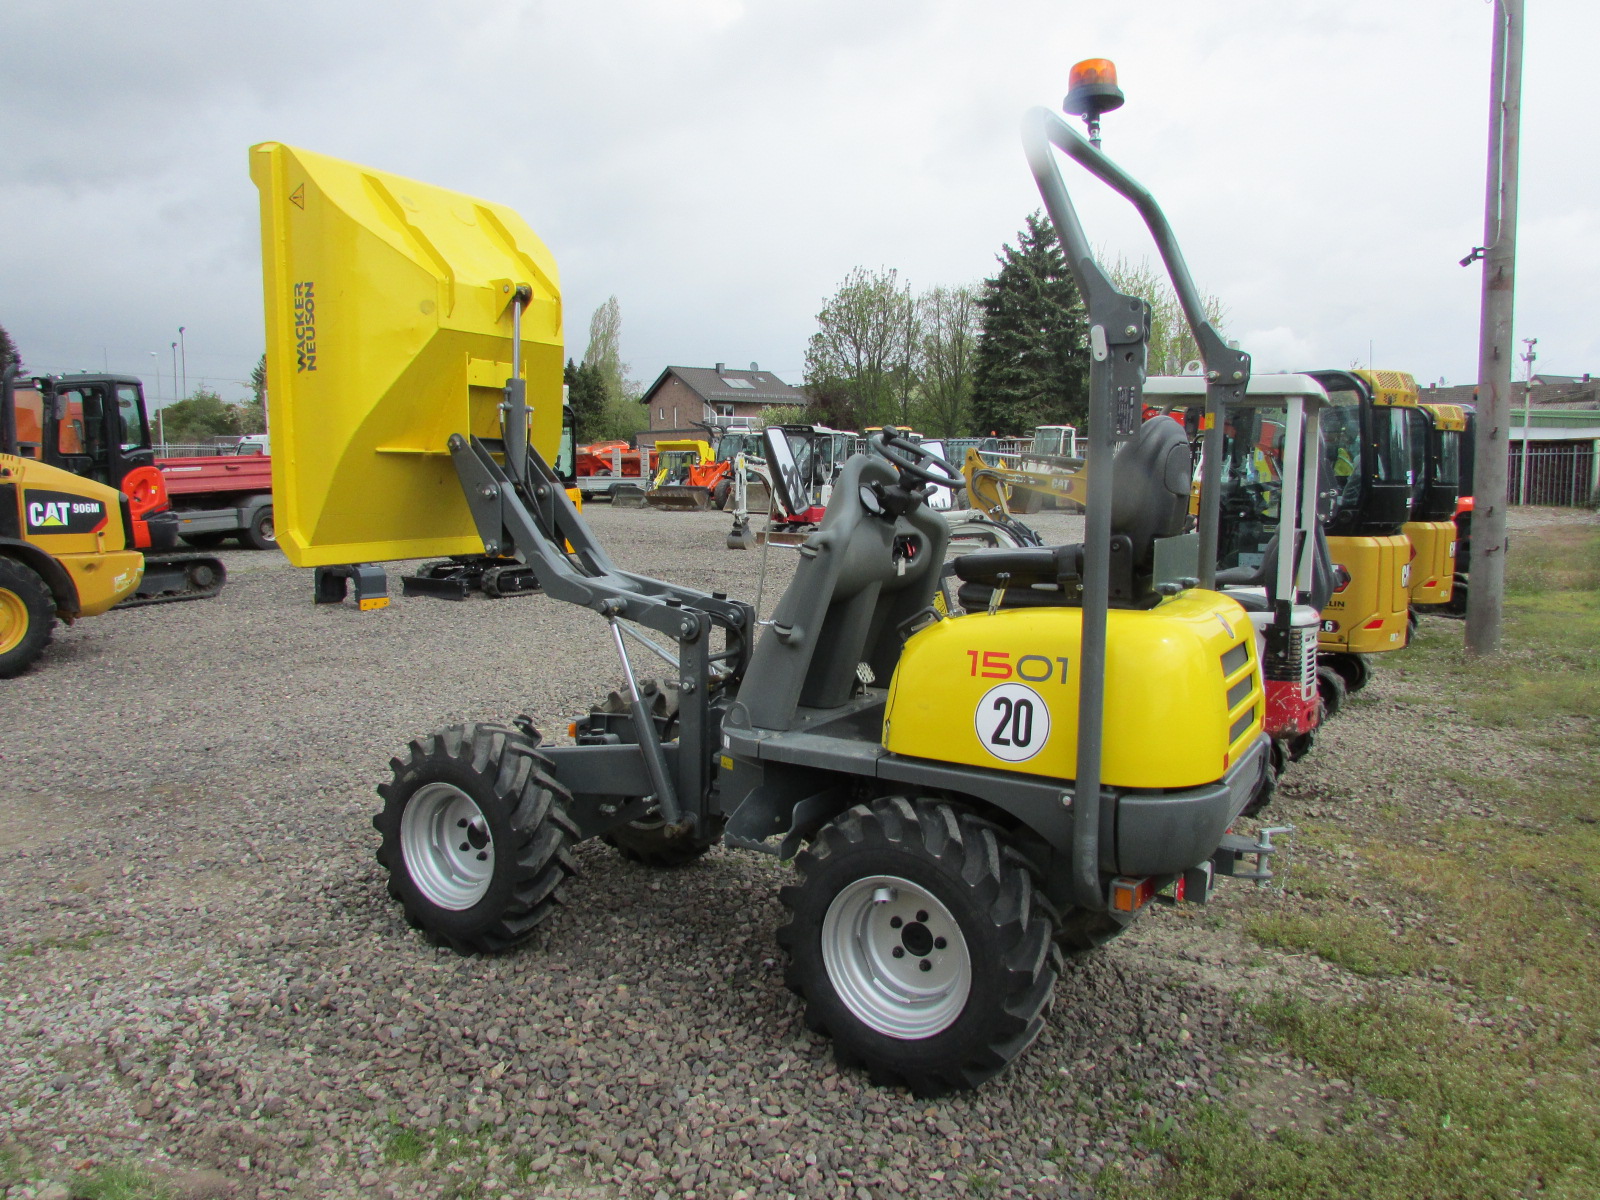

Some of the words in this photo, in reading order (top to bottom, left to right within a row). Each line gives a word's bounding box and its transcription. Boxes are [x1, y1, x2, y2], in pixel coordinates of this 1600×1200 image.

[294, 281, 307, 374] WACKER
[304, 281, 317, 372] NEUSON
[1051, 478, 1071, 491] CAT
[29, 502, 70, 527] CAT
[73, 503, 100, 513] 906M
[966, 649, 1069, 685] 1501
[991, 696, 1034, 748] 20
